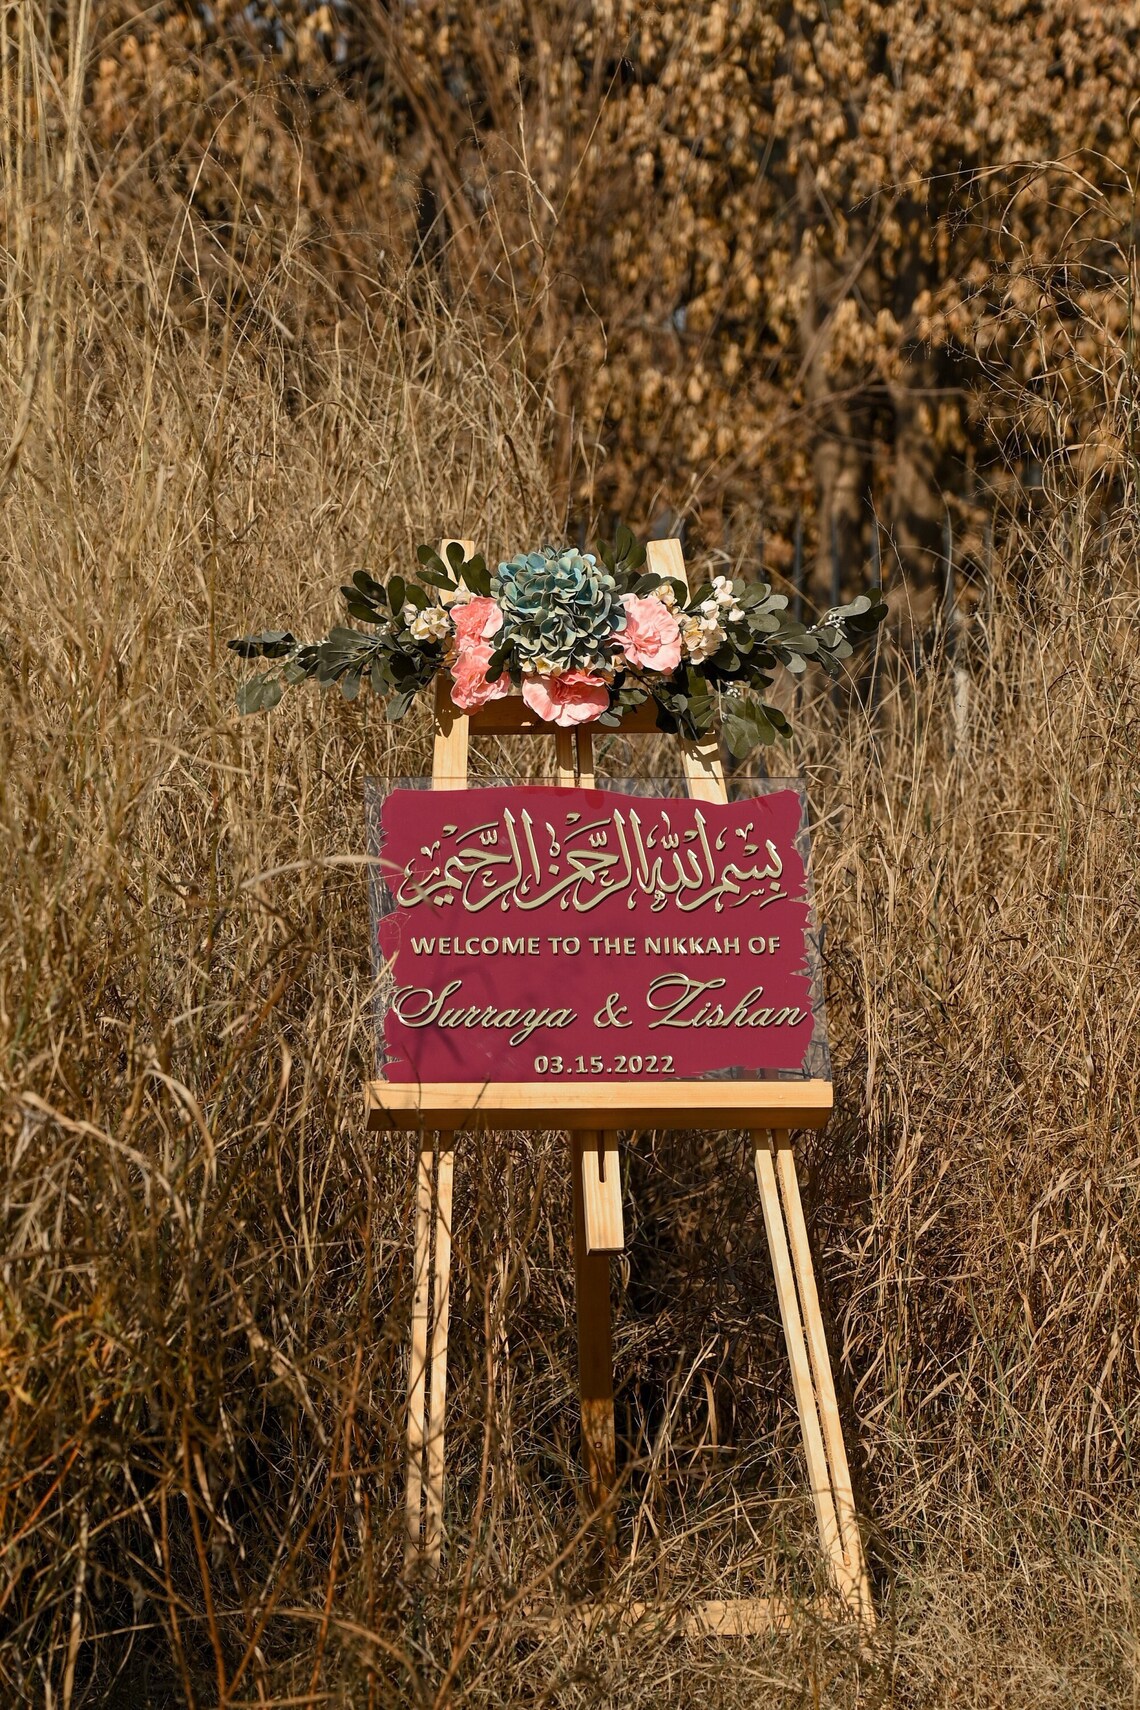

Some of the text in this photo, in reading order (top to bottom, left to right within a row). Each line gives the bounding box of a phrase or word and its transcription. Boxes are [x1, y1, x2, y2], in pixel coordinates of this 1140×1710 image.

[411, 936, 780, 955] WELCOME TO THE NIKKAH OF
[392, 972, 808, 1046] Surraya & Zishan
[533, 1055, 675, 1074] 03.15.2022
